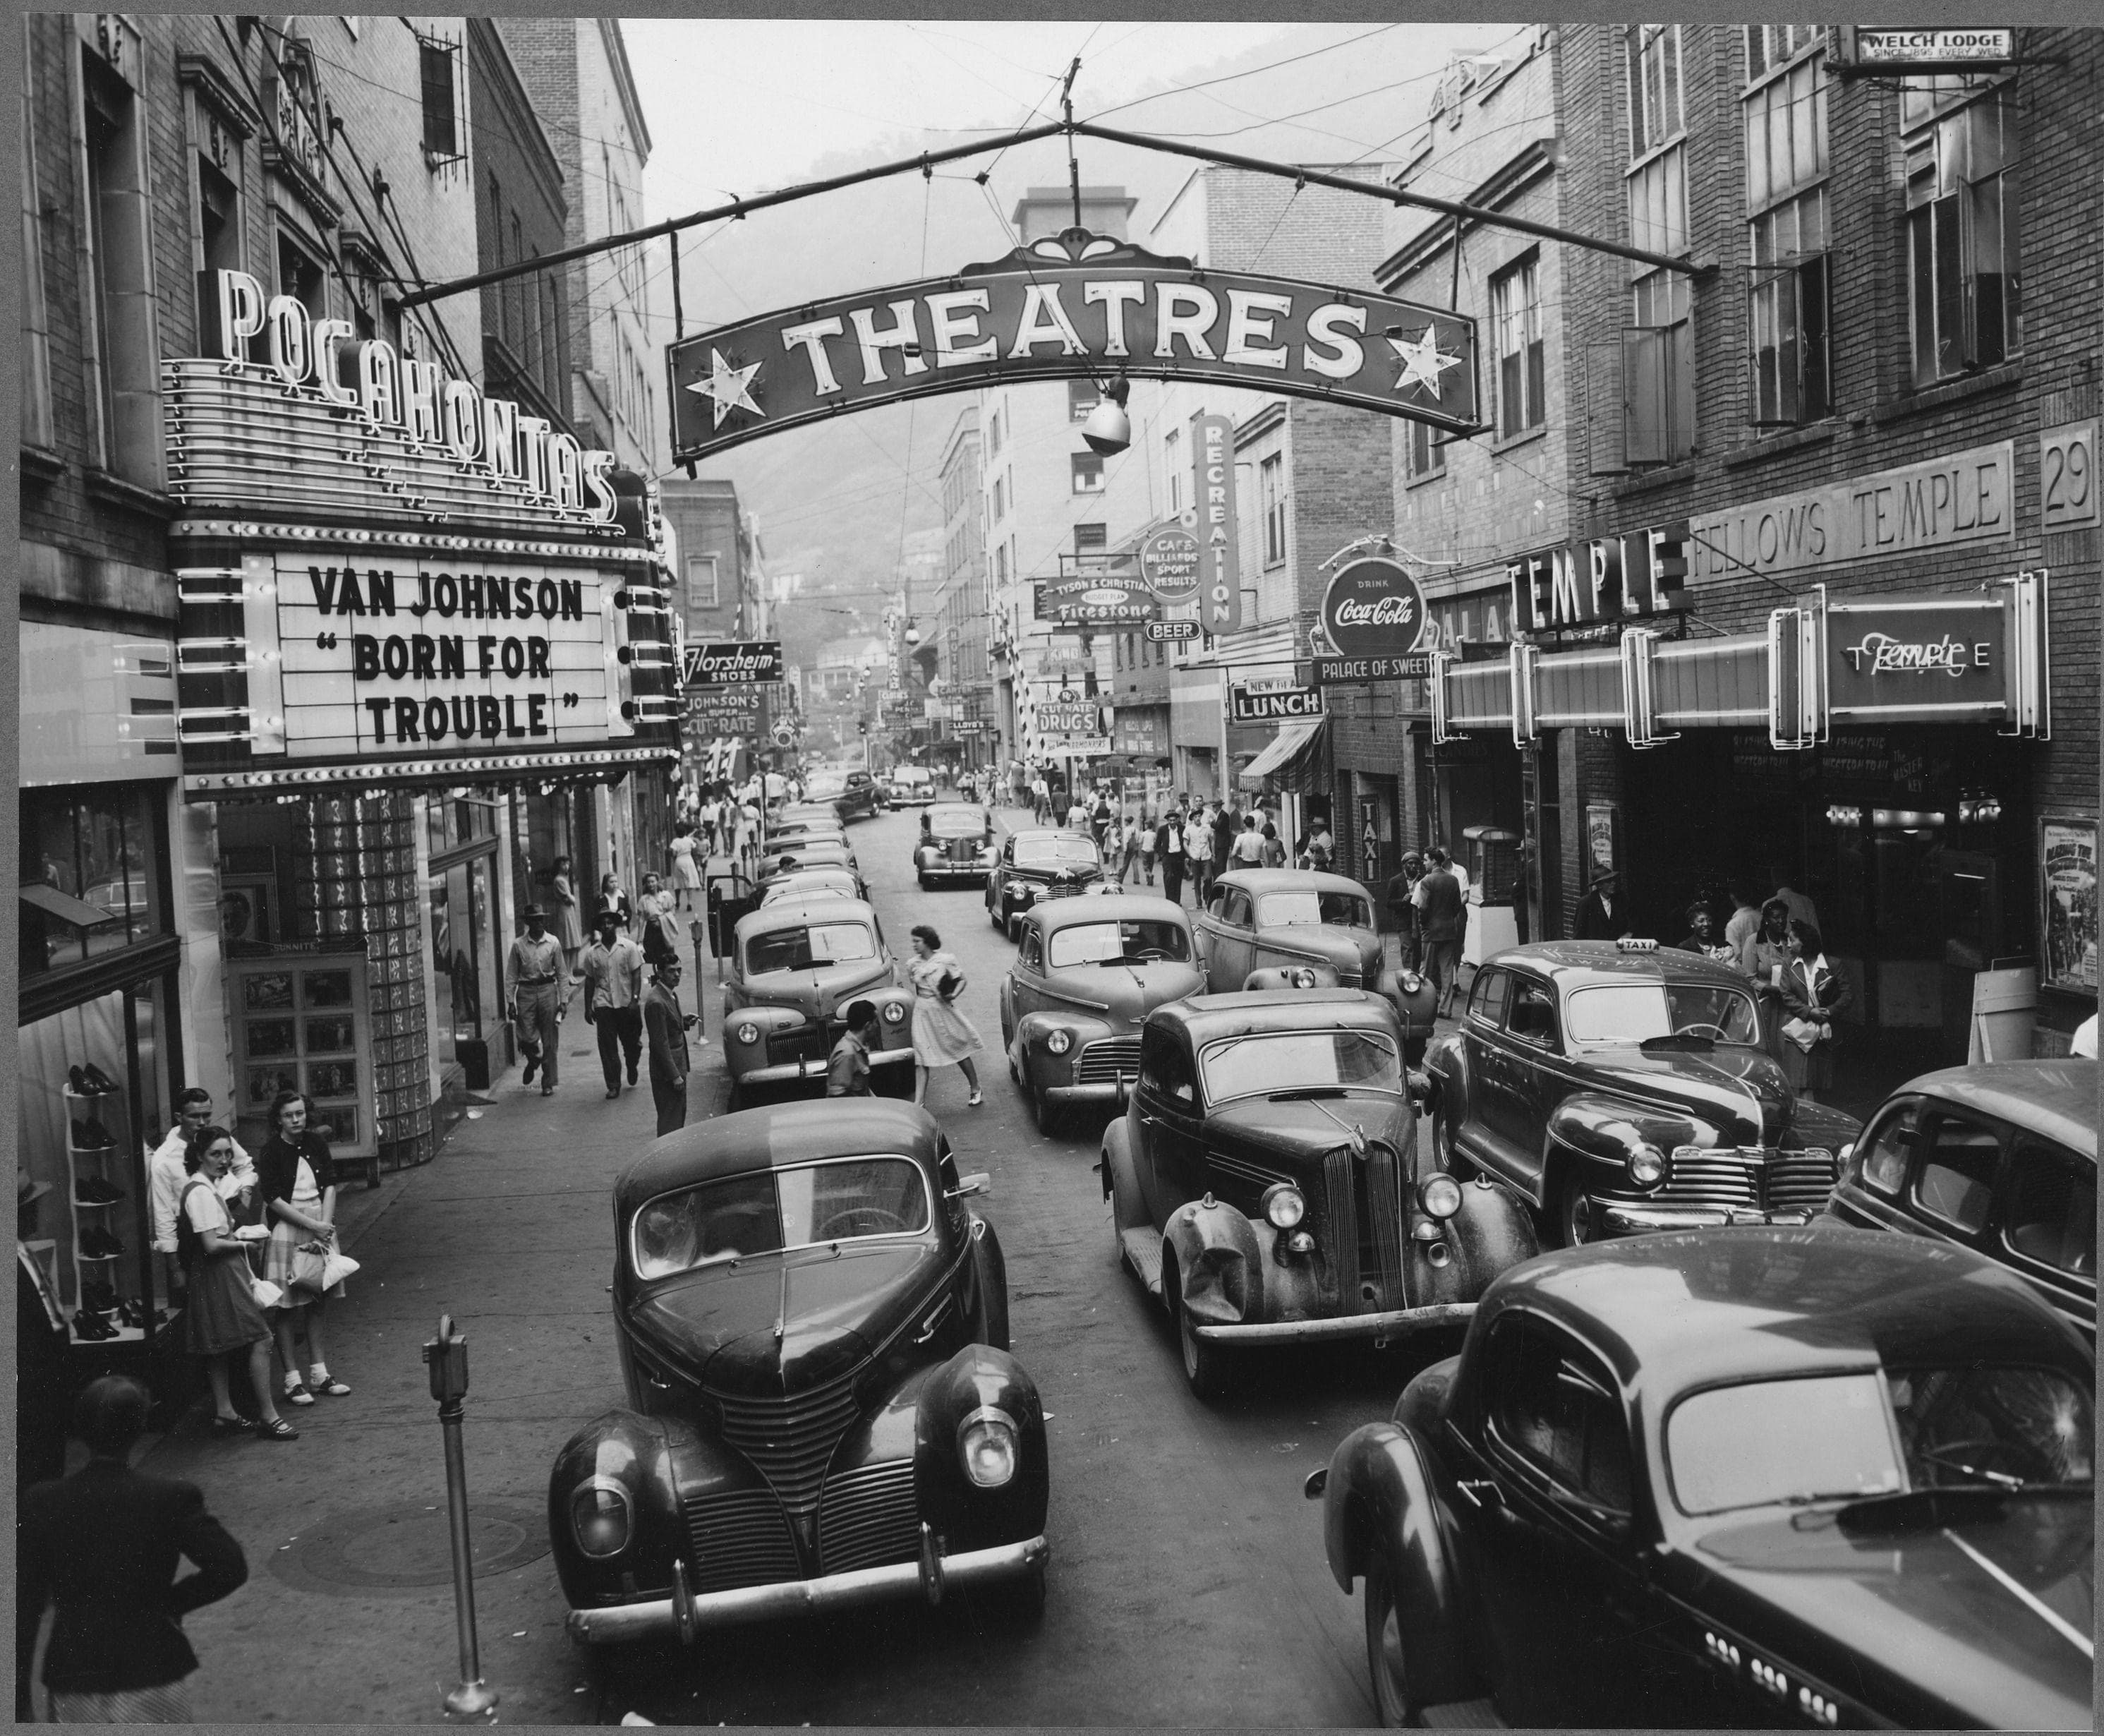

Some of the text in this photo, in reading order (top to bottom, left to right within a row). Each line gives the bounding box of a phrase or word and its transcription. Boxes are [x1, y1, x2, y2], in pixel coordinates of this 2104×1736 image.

[1869, 34, 2003, 47] WELCH LODGE
[1874, 49, 1904, 58] SINCE
[1910, 47, 1933, 56] 1895
[1939, 47, 1971, 56] EVERY
[780, 279, 1368, 398] THEATRES
[215, 268, 619, 526] POCAHONTAS
[2046, 440, 2091, 513] 29
[1205, 425, 1231, 622] RECREATION
[1694, 462, 2001, 577] FELLOWS TEMPLE
[1157, 564, 1190, 575] SPORT
[1506, 528, 1671, 629] TEMPLE
[1056, 579, 1089, 596] TYSON
[1091, 578, 1098, 589] &
[1154, 576, 1197, 588] RESULTS
[1357, 579, 1389, 589] DRINK
[307, 566, 583, 622] VAN JOHNSON
[1058, 603, 1152, 620] Firestone
[1335, 596, 1415, 627] Coca-Cola
[1153, 624, 1193, 638] BEER
[478, 634, 550, 680] FOR
[684, 644, 774, 684] Florsheim
[711, 670, 756, 682] SHOES
[1322, 661, 1367, 679] PALACE
[1372, 660, 1388, 676] OF
[1250, 679, 1274, 692] NEW
[686, 694, 760, 712] JOHNSON'S
[1238, 692, 1319, 718] LUNCH
[689, 716, 756, 735] CUT-RATE
[953, 720, 984, 729] LLOYD'S
[1040, 713, 1094, 731] DRUGS
[1362, 803, 1377, 880] TAXI
[1625, 941, 1652, 949] TAXI
